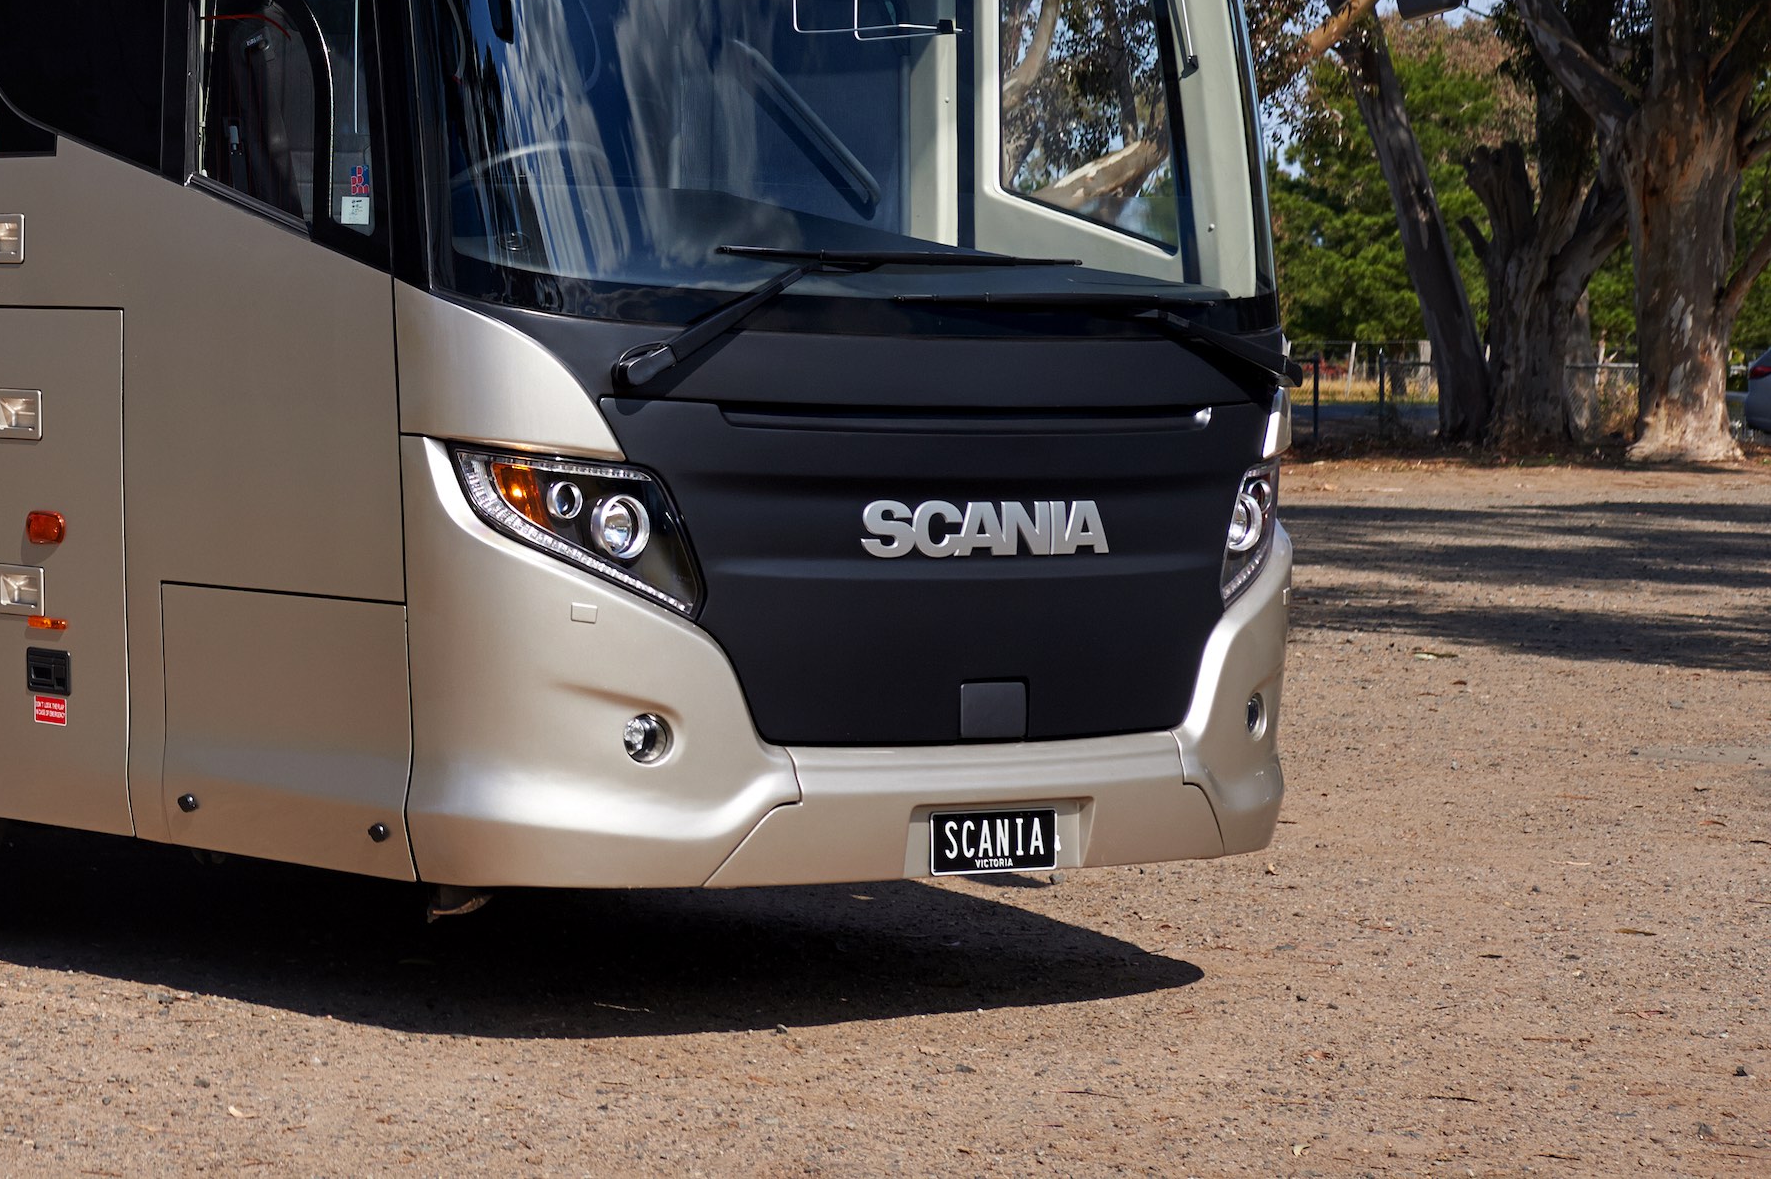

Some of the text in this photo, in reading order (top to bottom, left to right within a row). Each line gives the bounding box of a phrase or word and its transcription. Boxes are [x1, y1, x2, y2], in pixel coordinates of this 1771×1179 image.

[860, 499, 1110, 558] SCANIA
[944, 817, 1045, 859] SCANIA
[975, 858, 1014, 868] VICTORIA
